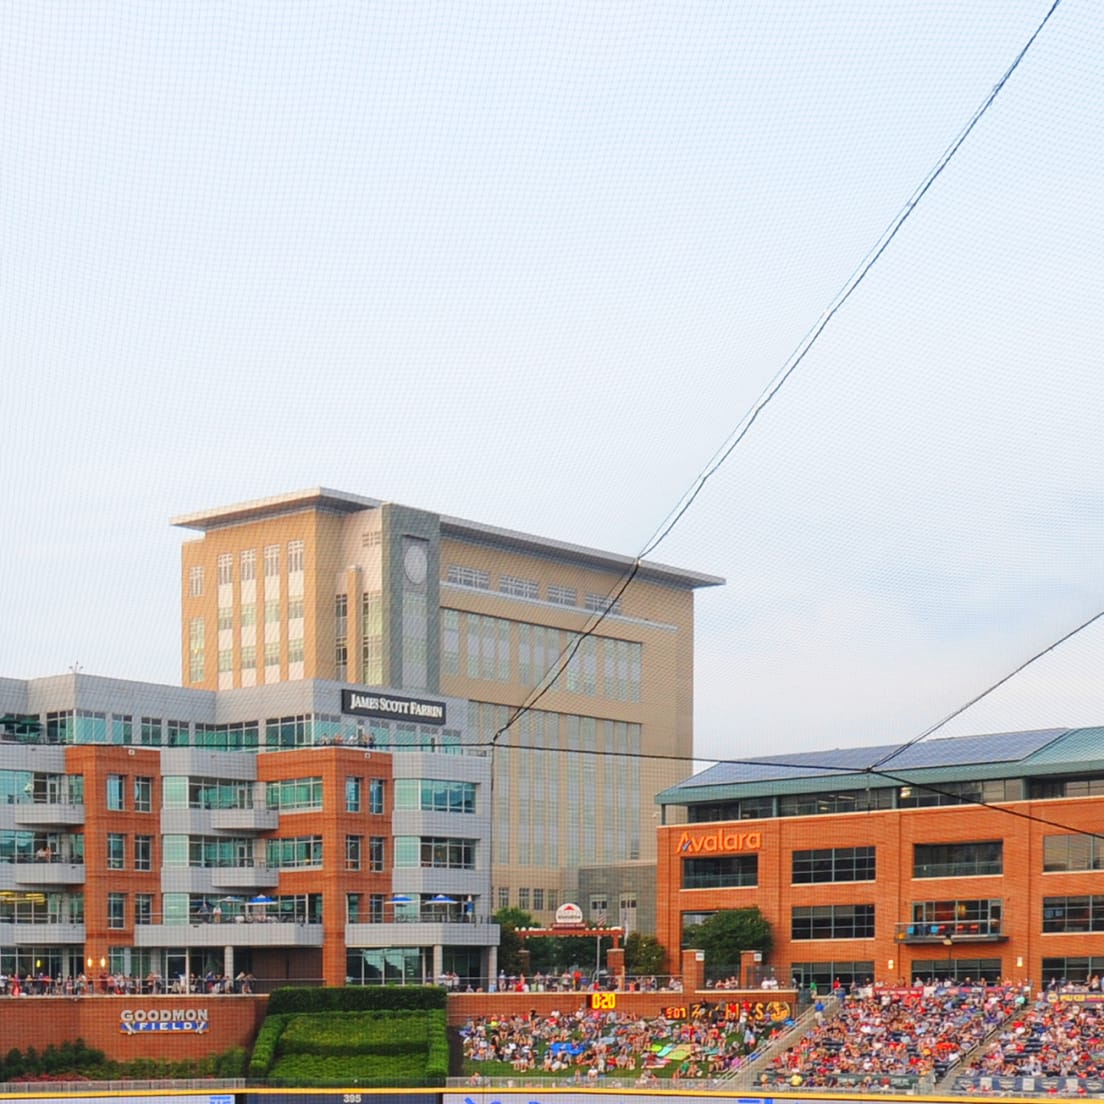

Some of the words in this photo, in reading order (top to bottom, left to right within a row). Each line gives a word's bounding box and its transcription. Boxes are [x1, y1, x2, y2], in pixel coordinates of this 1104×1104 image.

[350, 694, 378, 710] JAMES
[379, 698, 409, 714] SCOTT
[676, 829, 762, 854] Avalara
[120, 1008, 208, 1022] GOODMON
[139, 1022, 193, 1030] FIELD
